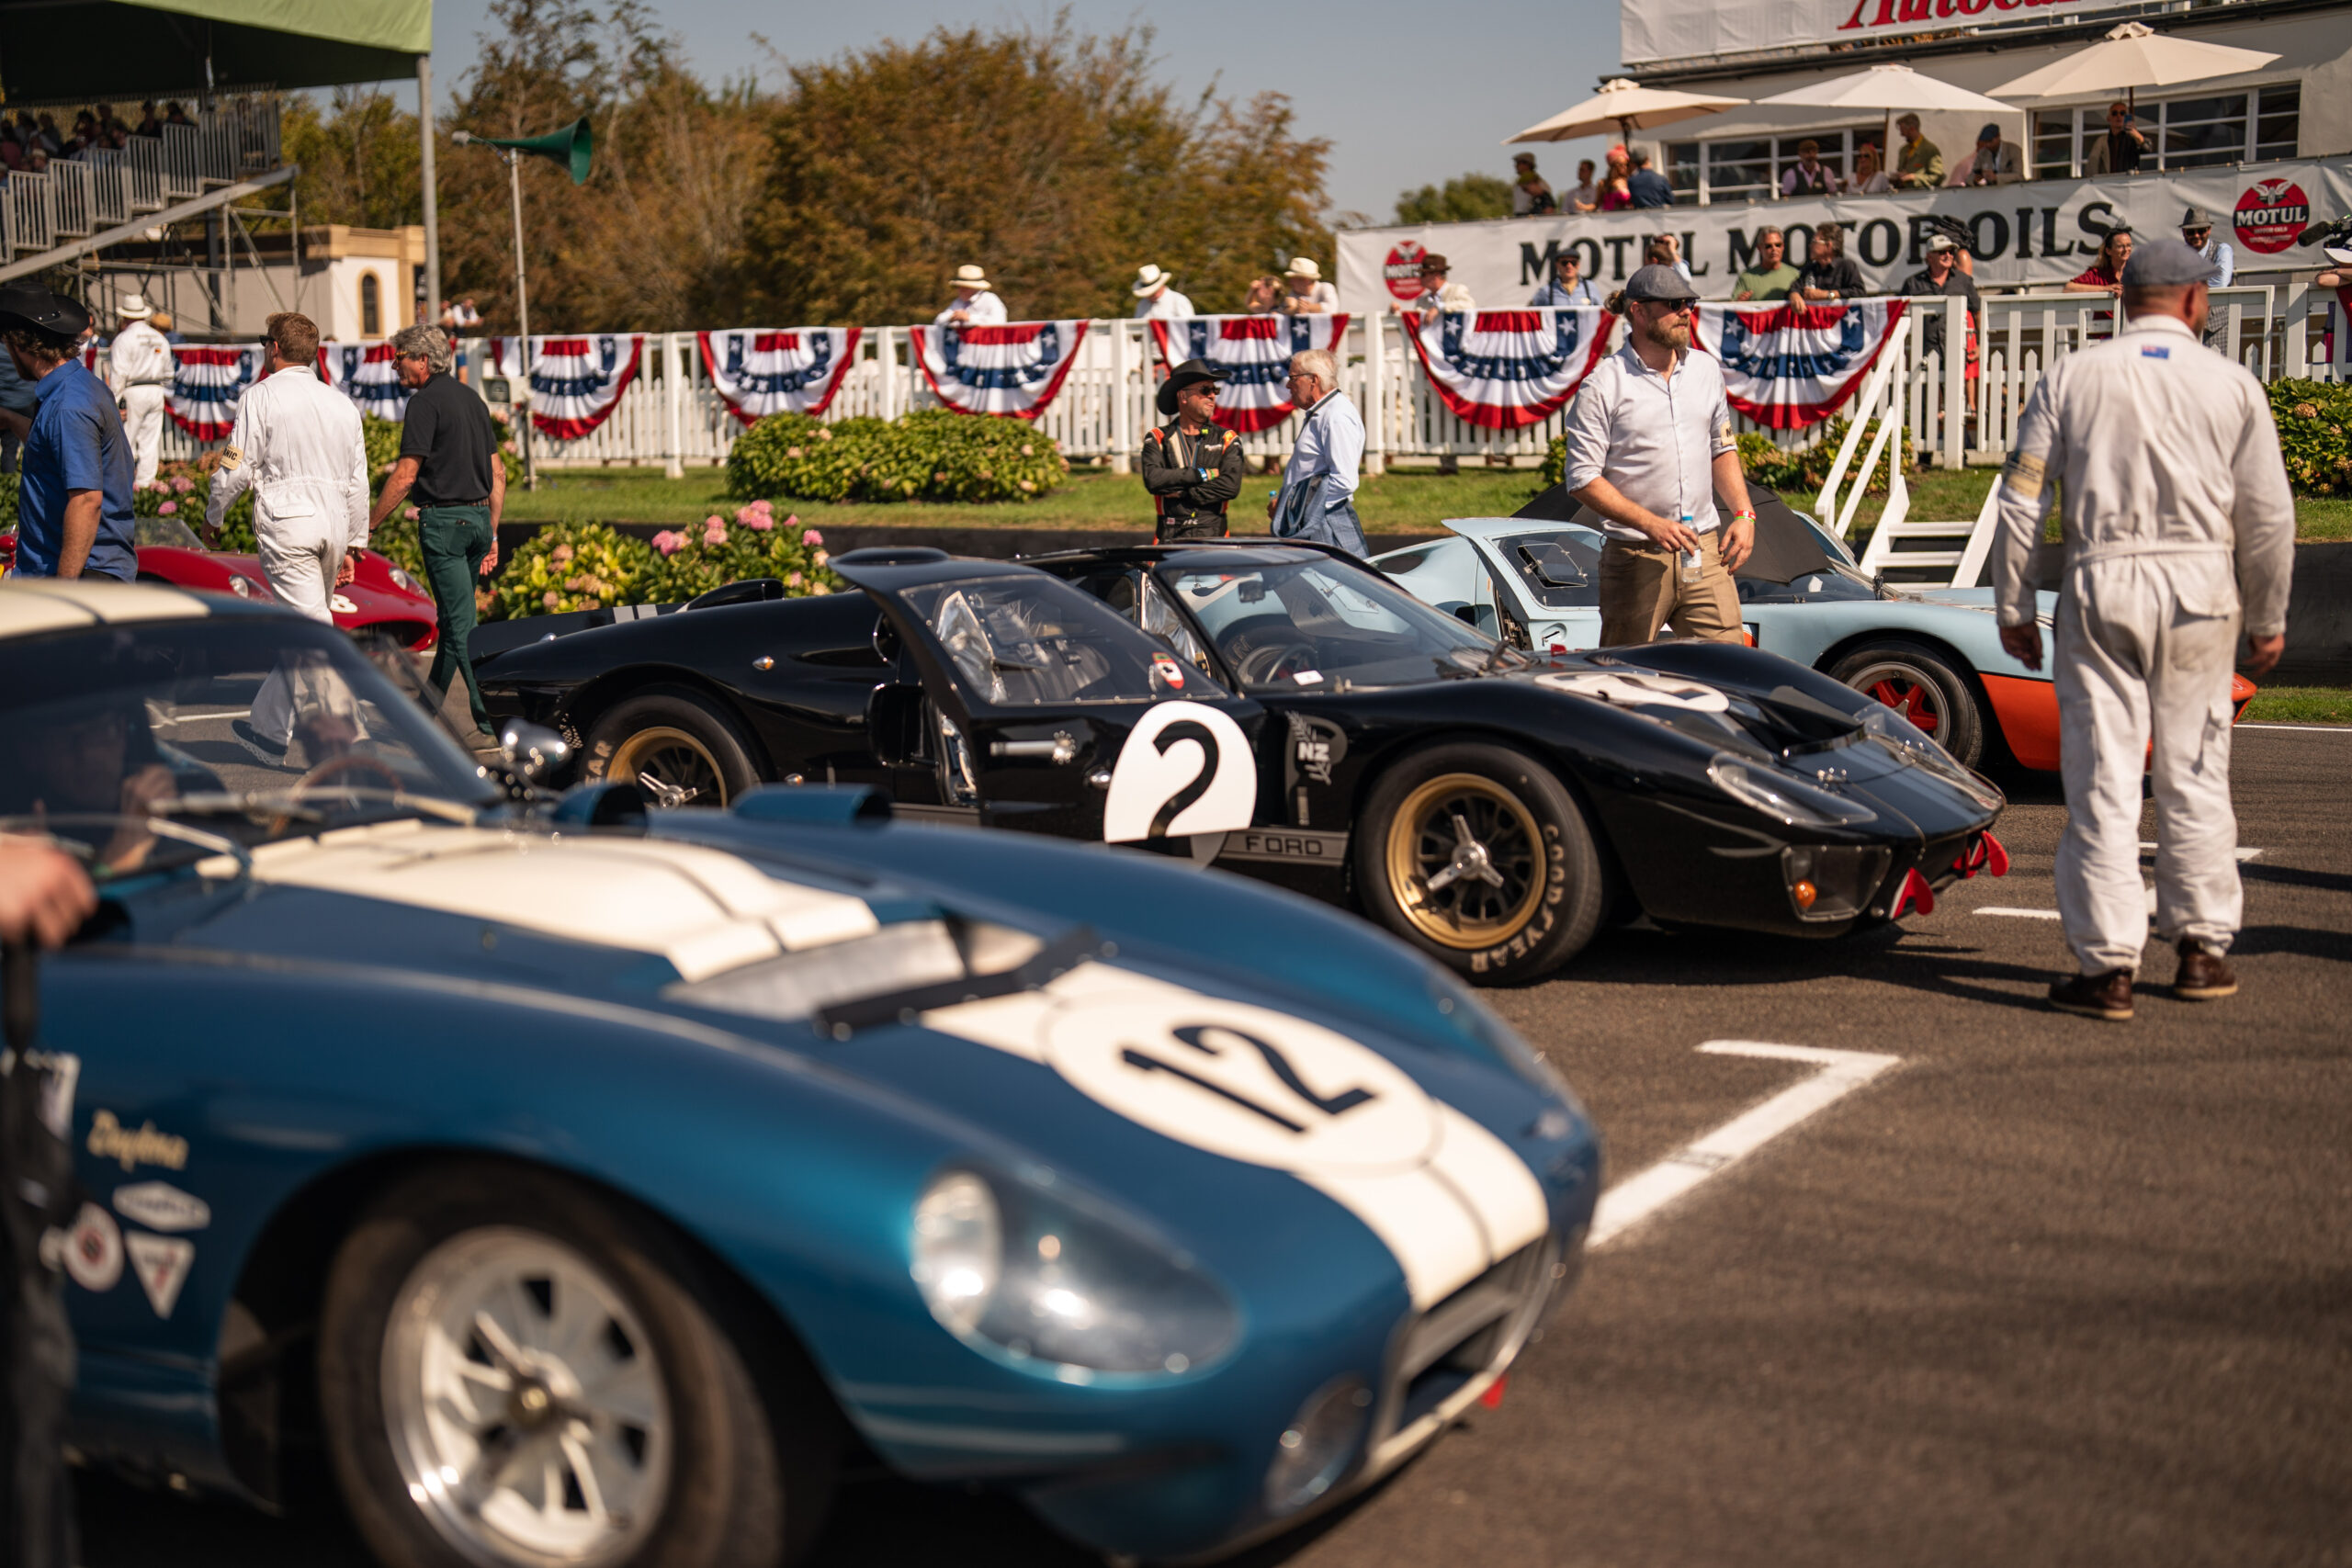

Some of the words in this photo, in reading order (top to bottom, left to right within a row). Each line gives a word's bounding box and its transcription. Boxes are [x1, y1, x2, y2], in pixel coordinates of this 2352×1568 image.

[1968, 200, 2113, 263] OILS
[2236, 207, 2307, 226] MOTUL
[1297, 741, 1330, 761] NZ
[1152, 719, 1220, 840] 2
[1246, 835, 1324, 856] FORD
[1122, 1023, 1377, 1134] 12
